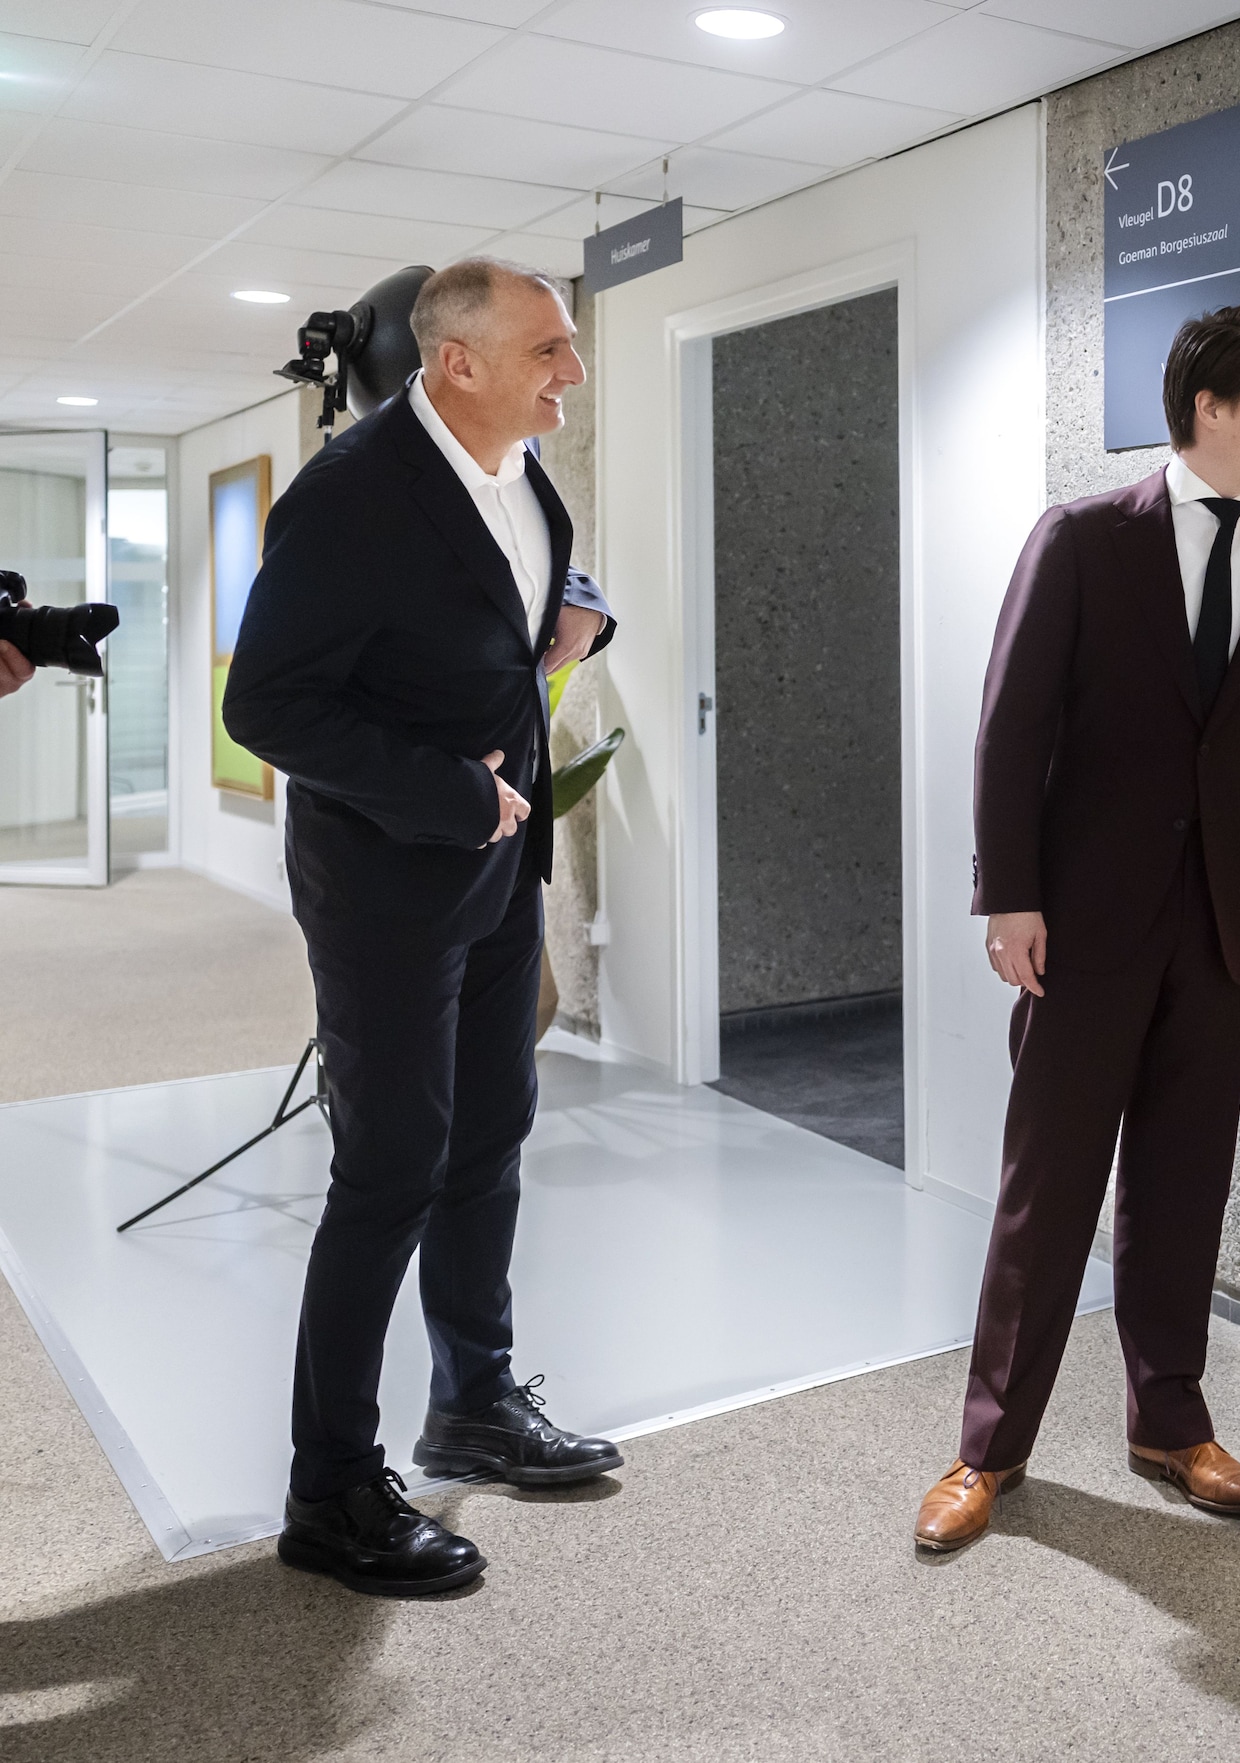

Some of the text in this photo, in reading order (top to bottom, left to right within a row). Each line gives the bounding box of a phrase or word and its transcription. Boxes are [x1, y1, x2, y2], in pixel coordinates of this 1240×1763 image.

[1118, 174, 1193, 229] Vleugel D8
[611, 238, 651, 264] Huiskamer
[1119, 224, 1228, 265] Goeman Borgesiuszaal
